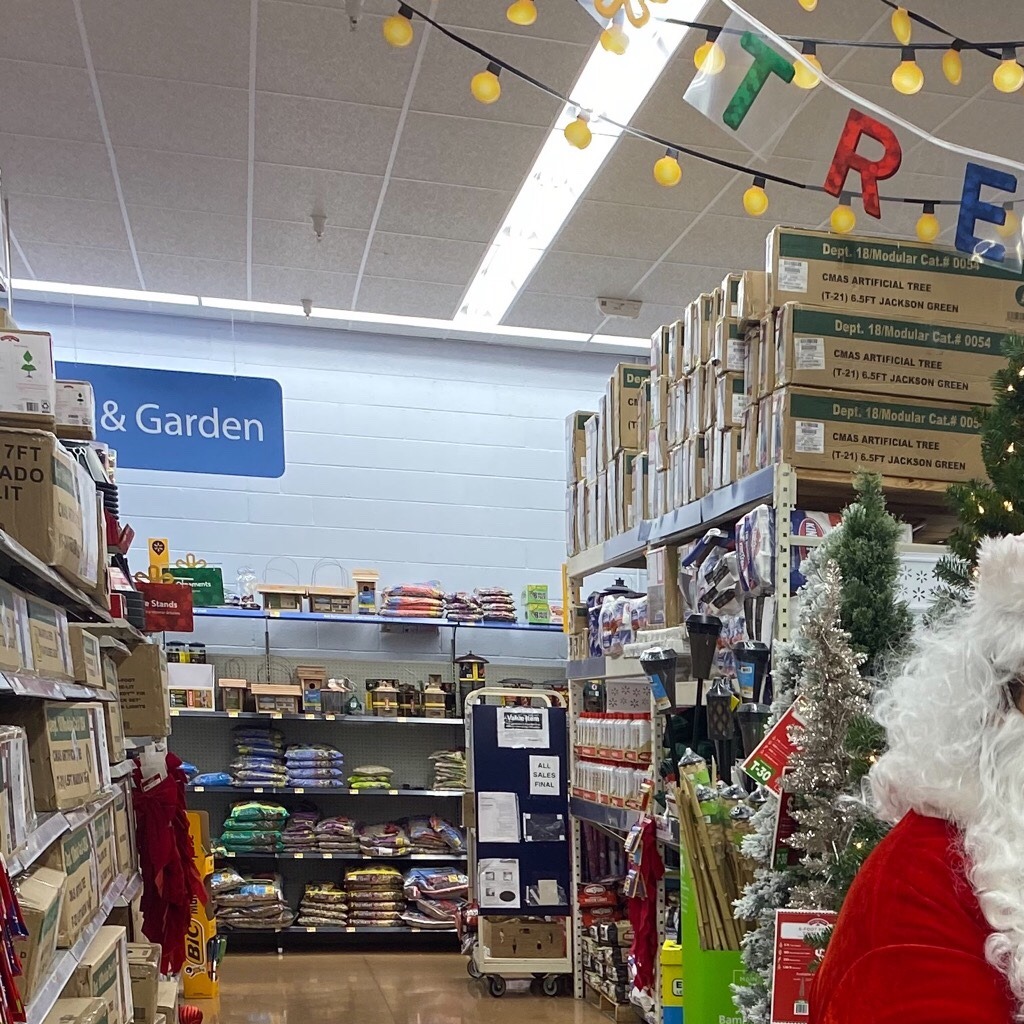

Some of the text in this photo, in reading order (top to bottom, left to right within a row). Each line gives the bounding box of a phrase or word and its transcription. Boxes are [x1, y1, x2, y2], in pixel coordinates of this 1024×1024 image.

[822, 243, 853, 260] Dept.
[856, 246, 918, 266] 18/Modular
[920, 252, 951, 268] Cat.#
[821, 273, 932, 293] CMAS ARTIFICIAL TREE
[821, 291, 960, 314] (T-21) 6.5FT JACKSON GREEN
[833, 319, 992, 350] Dept. 18/Modular Cat.# 0054
[833, 349, 943, 370] CMAS ARTIFICIAL TREE
[832, 367, 969, 391] (T-21) 6.5FT JACKSON GREEN
[100, 400, 264, 442] & Garden
[832, 403, 983, 430] Dept. 18/Modular Cat.# 005
[832, 432, 941, 451] CMAS ARTIFICIAL TREE
[4, 444, 42, 462] 7FT
[831, 450, 967, 472] (T-21) 6.5FT JACKSON GREEN
[151, 600, 178, 608] Stands
[532, 771, 556, 779] SALES
[750, 760, 772, 781] T-30
[718, 1014, 745, 1024] Bam
